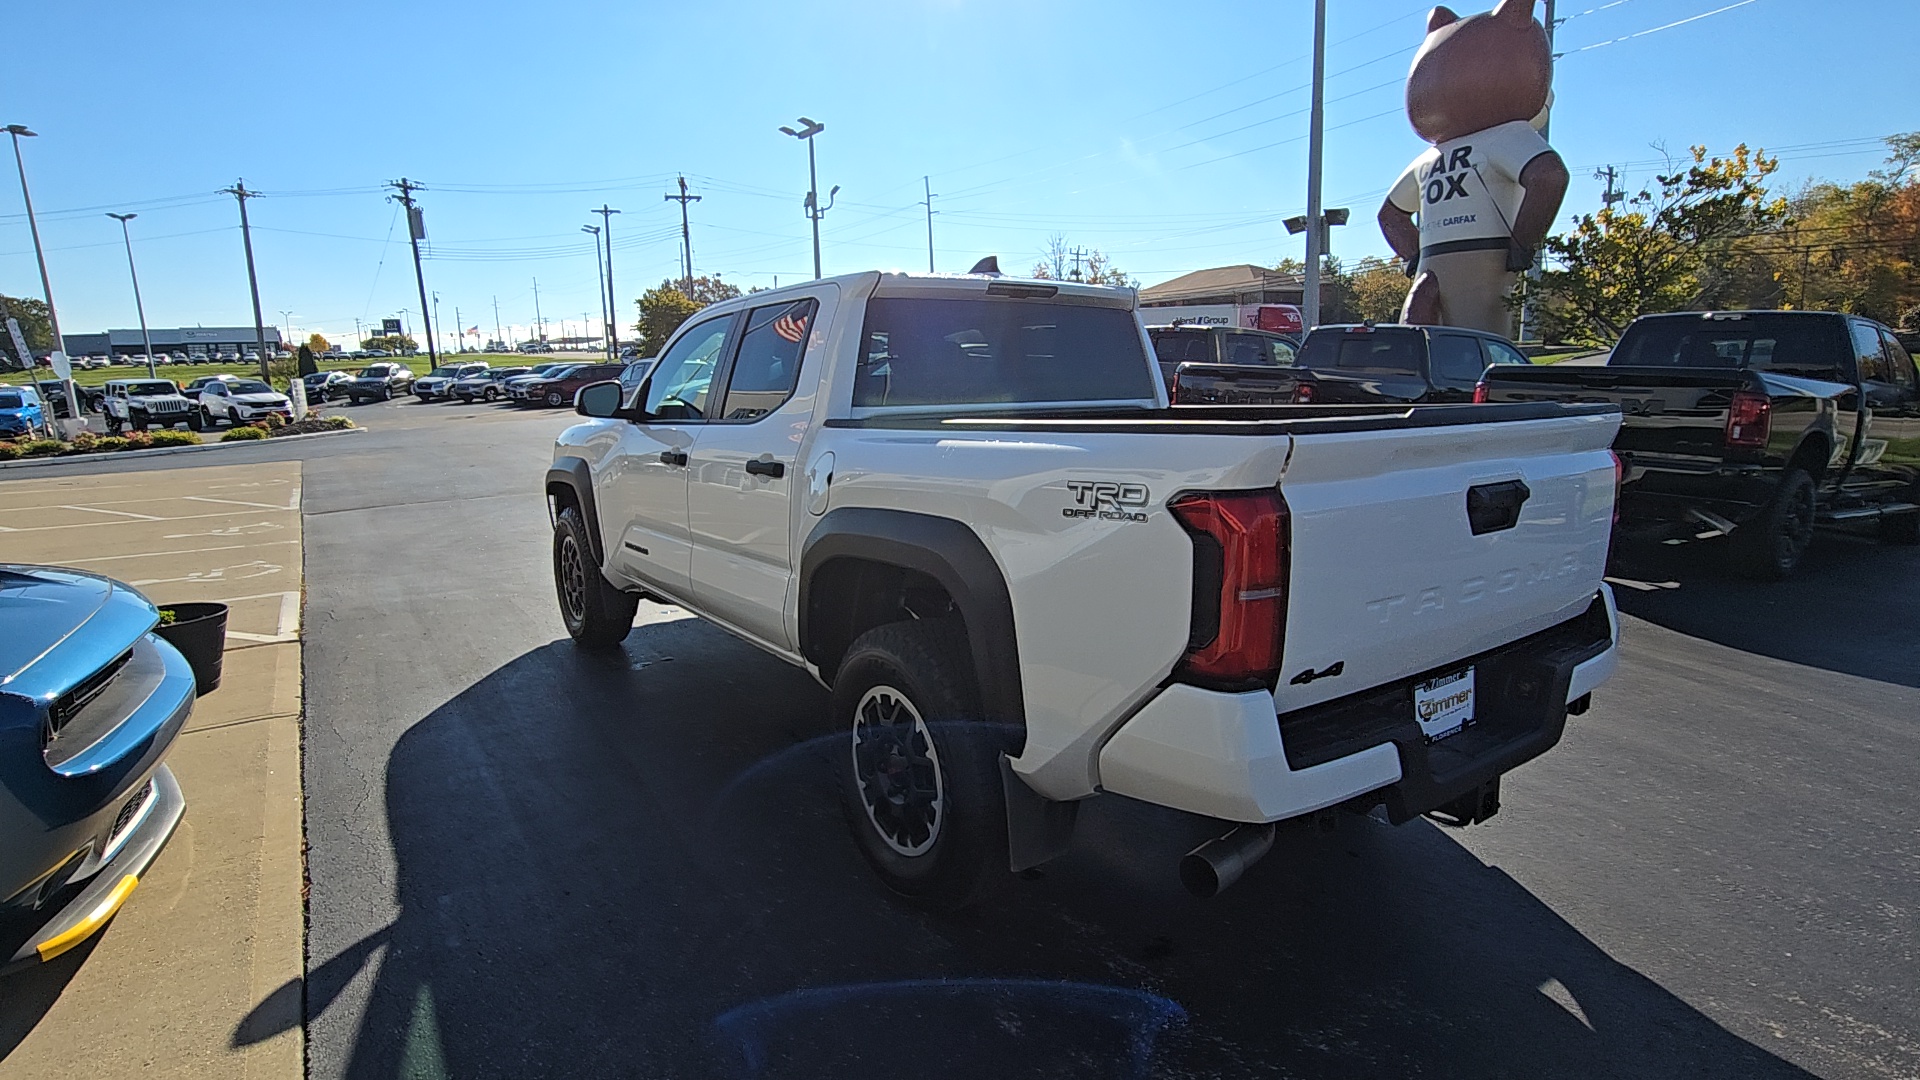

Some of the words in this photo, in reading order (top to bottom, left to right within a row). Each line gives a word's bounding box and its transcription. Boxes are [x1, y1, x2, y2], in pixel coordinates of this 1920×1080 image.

[1443, 214, 1476, 227] CARFAX
[1203, 316, 1229, 327] Group
[1067, 480, 1150, 513] TRD
[1062, 508, 1097, 519] OFF
[1098, 510, 1149, 524] ROAD
[1365, 551, 1580, 625] TACOMA
[1419, 688, 1472, 720] Zimmer
[1432, 726, 1462, 742] FLORENCE
